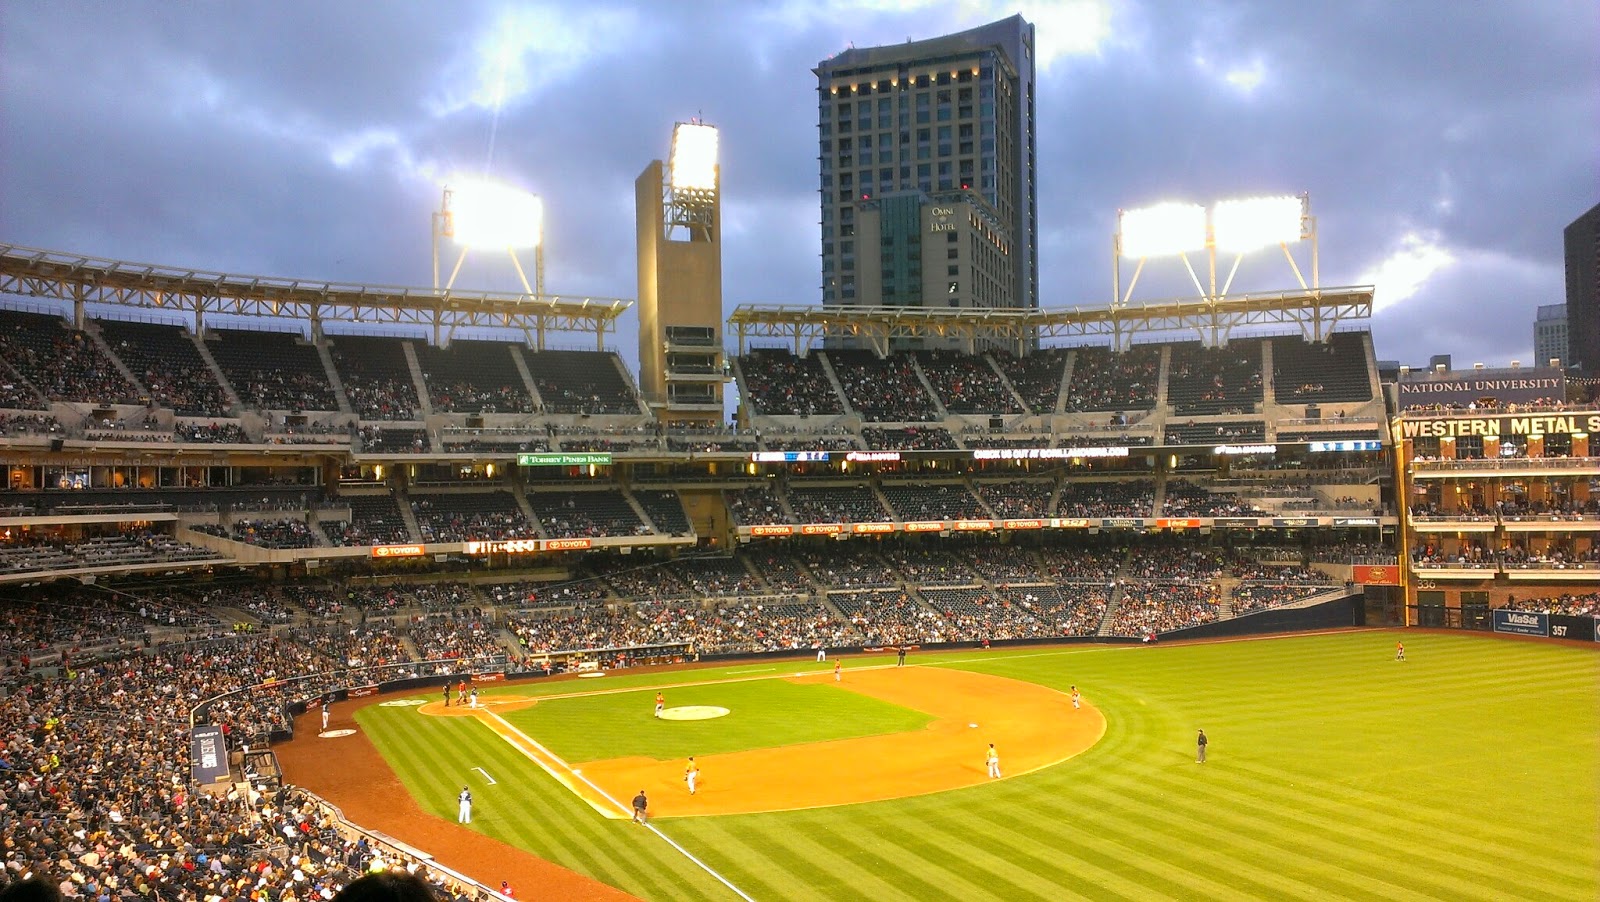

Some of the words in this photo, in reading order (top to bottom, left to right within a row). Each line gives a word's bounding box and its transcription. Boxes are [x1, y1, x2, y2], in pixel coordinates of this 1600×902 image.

[1402, 382, 1471, 394] NATIONAL
[1475, 379, 1559, 391] UNIVERSITY
[1403, 419, 1500, 437] WESTERN
[1511, 416, 1582, 434] METAL
[588, 455, 609, 463] BANK
[1417, 579, 1436, 589] 336
[1507, 613, 1539, 625] ViaSat
[1552, 625, 1567, 636] 357
